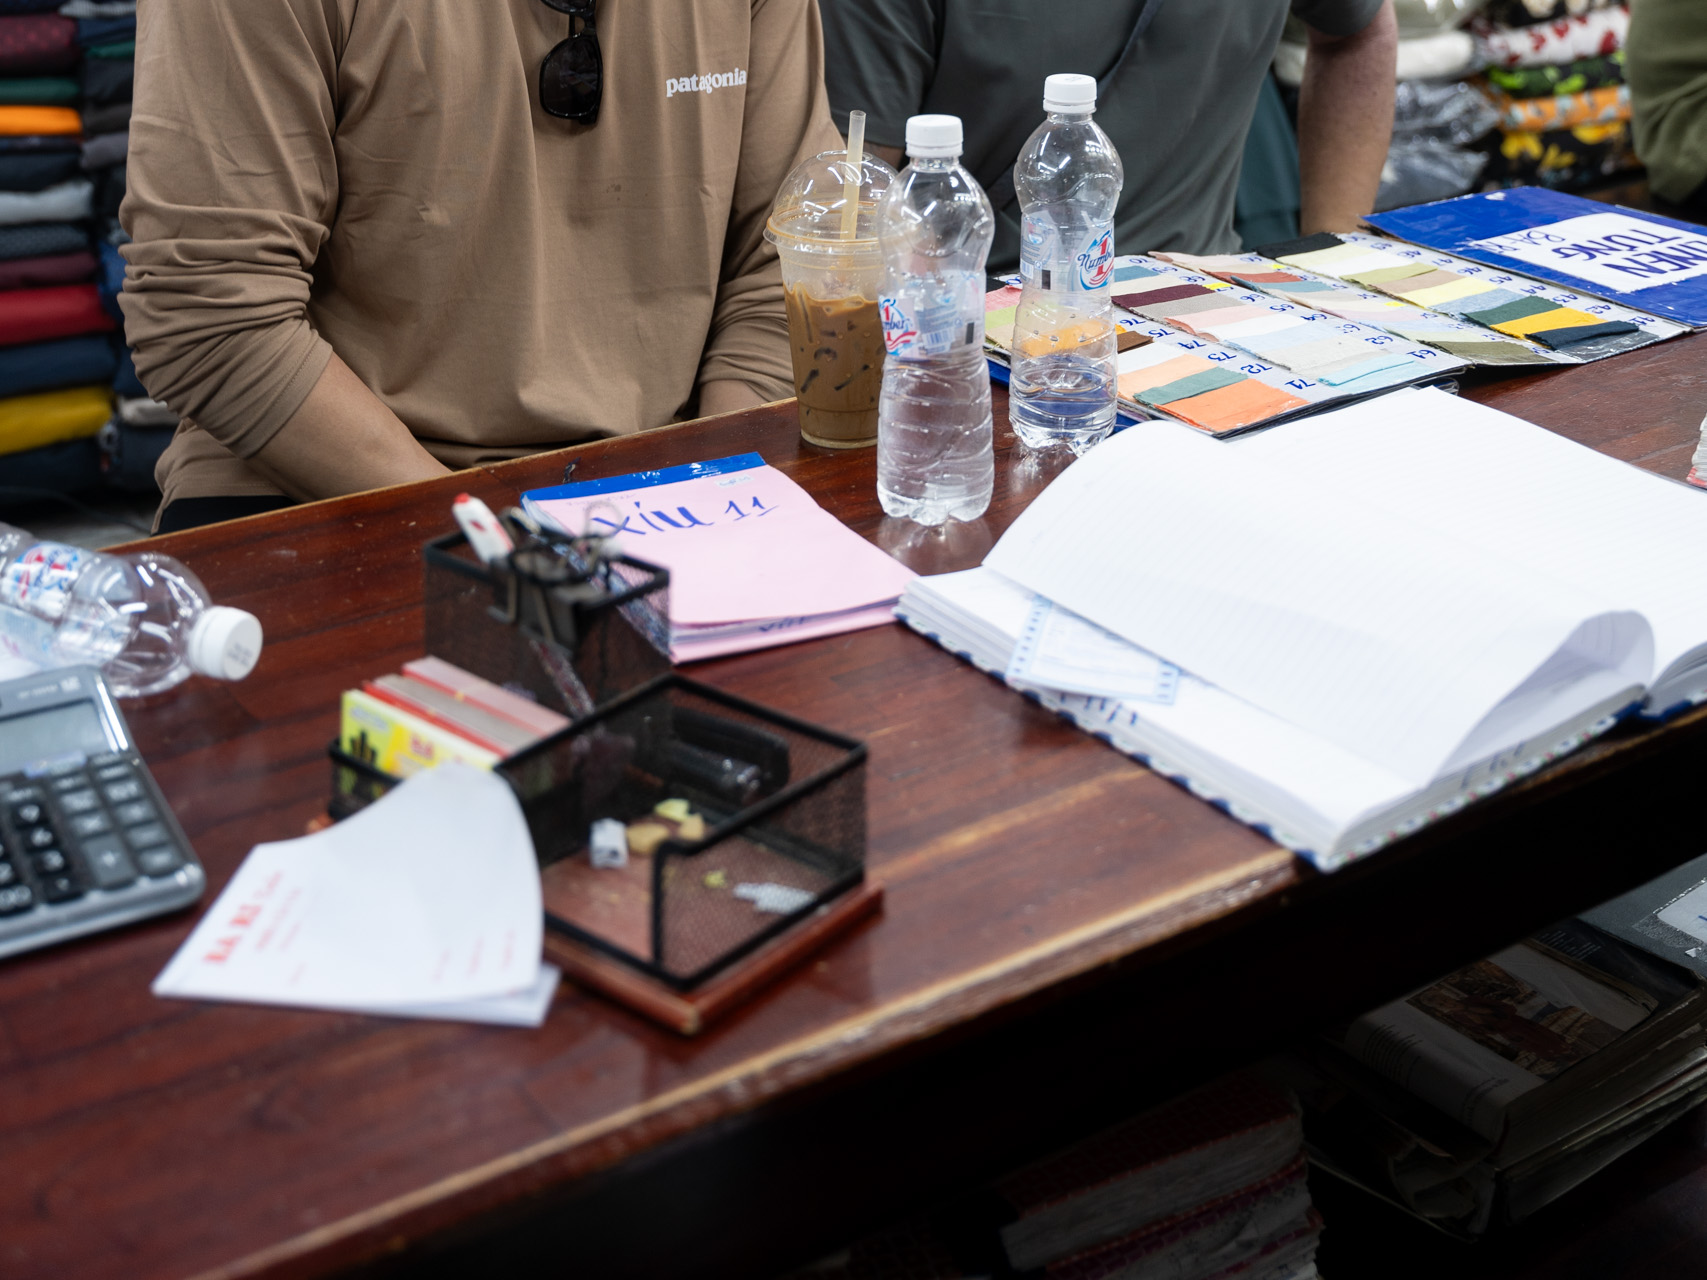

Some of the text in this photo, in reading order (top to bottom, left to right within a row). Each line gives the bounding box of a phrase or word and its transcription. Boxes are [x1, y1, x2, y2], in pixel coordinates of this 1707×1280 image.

[666, 67, 747, 97] patagonia
[1489, 275, 1513, 285] 45
[1520, 284, 1547, 295] 44
[1240, 293, 1266, 302] 66
[1552, 293, 1579, 304] 43
[1269, 303, 1295, 312] 65
[1585, 304, 1612, 315] 42
[1119, 318, 1146, 326] 76
[1300, 313, 1328, 321] 64
[1148, 328, 1175, 338] 75
[1177, 340, 1206, 350] 74
[1364, 335, 1394, 345] 62
[1208, 351, 1237, 362] 73
[1406, 349, 1437, 359] 61
[1240, 363, 1272, 375] 72
[1284, 379, 1316, 390] 71
